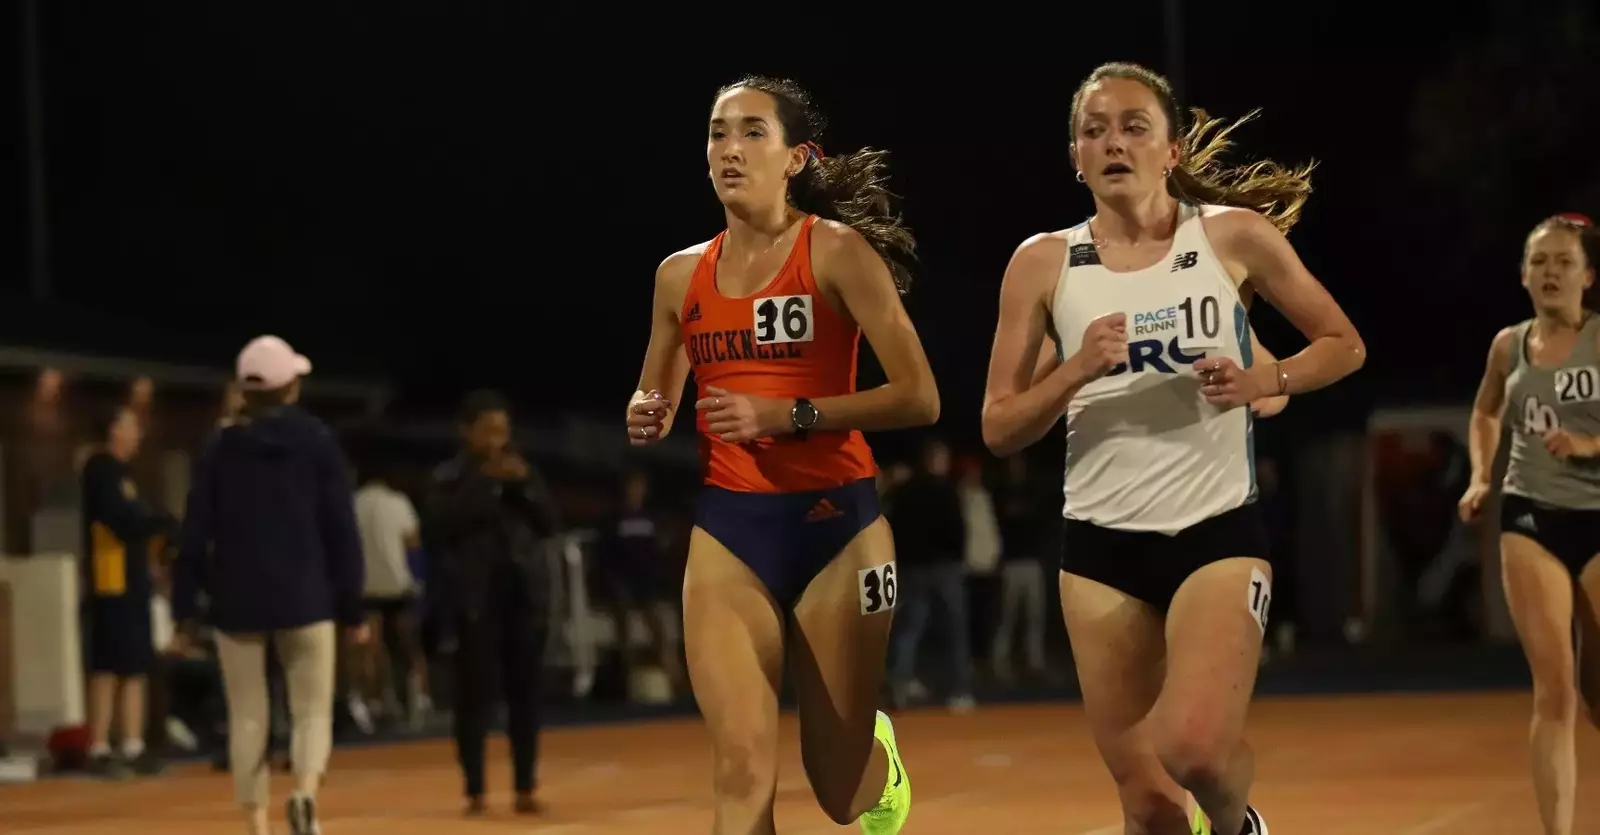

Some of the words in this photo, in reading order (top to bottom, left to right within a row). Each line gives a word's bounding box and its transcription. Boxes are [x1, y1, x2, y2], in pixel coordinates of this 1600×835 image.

[757, 297, 808, 341] 36
[1135, 319, 1178, 336] RUNN
[1178, 296, 1220, 339] 10
[1105, 336, 1206, 376] RC
[1560, 369, 1593, 402] 20
[864, 564, 895, 613] 36
